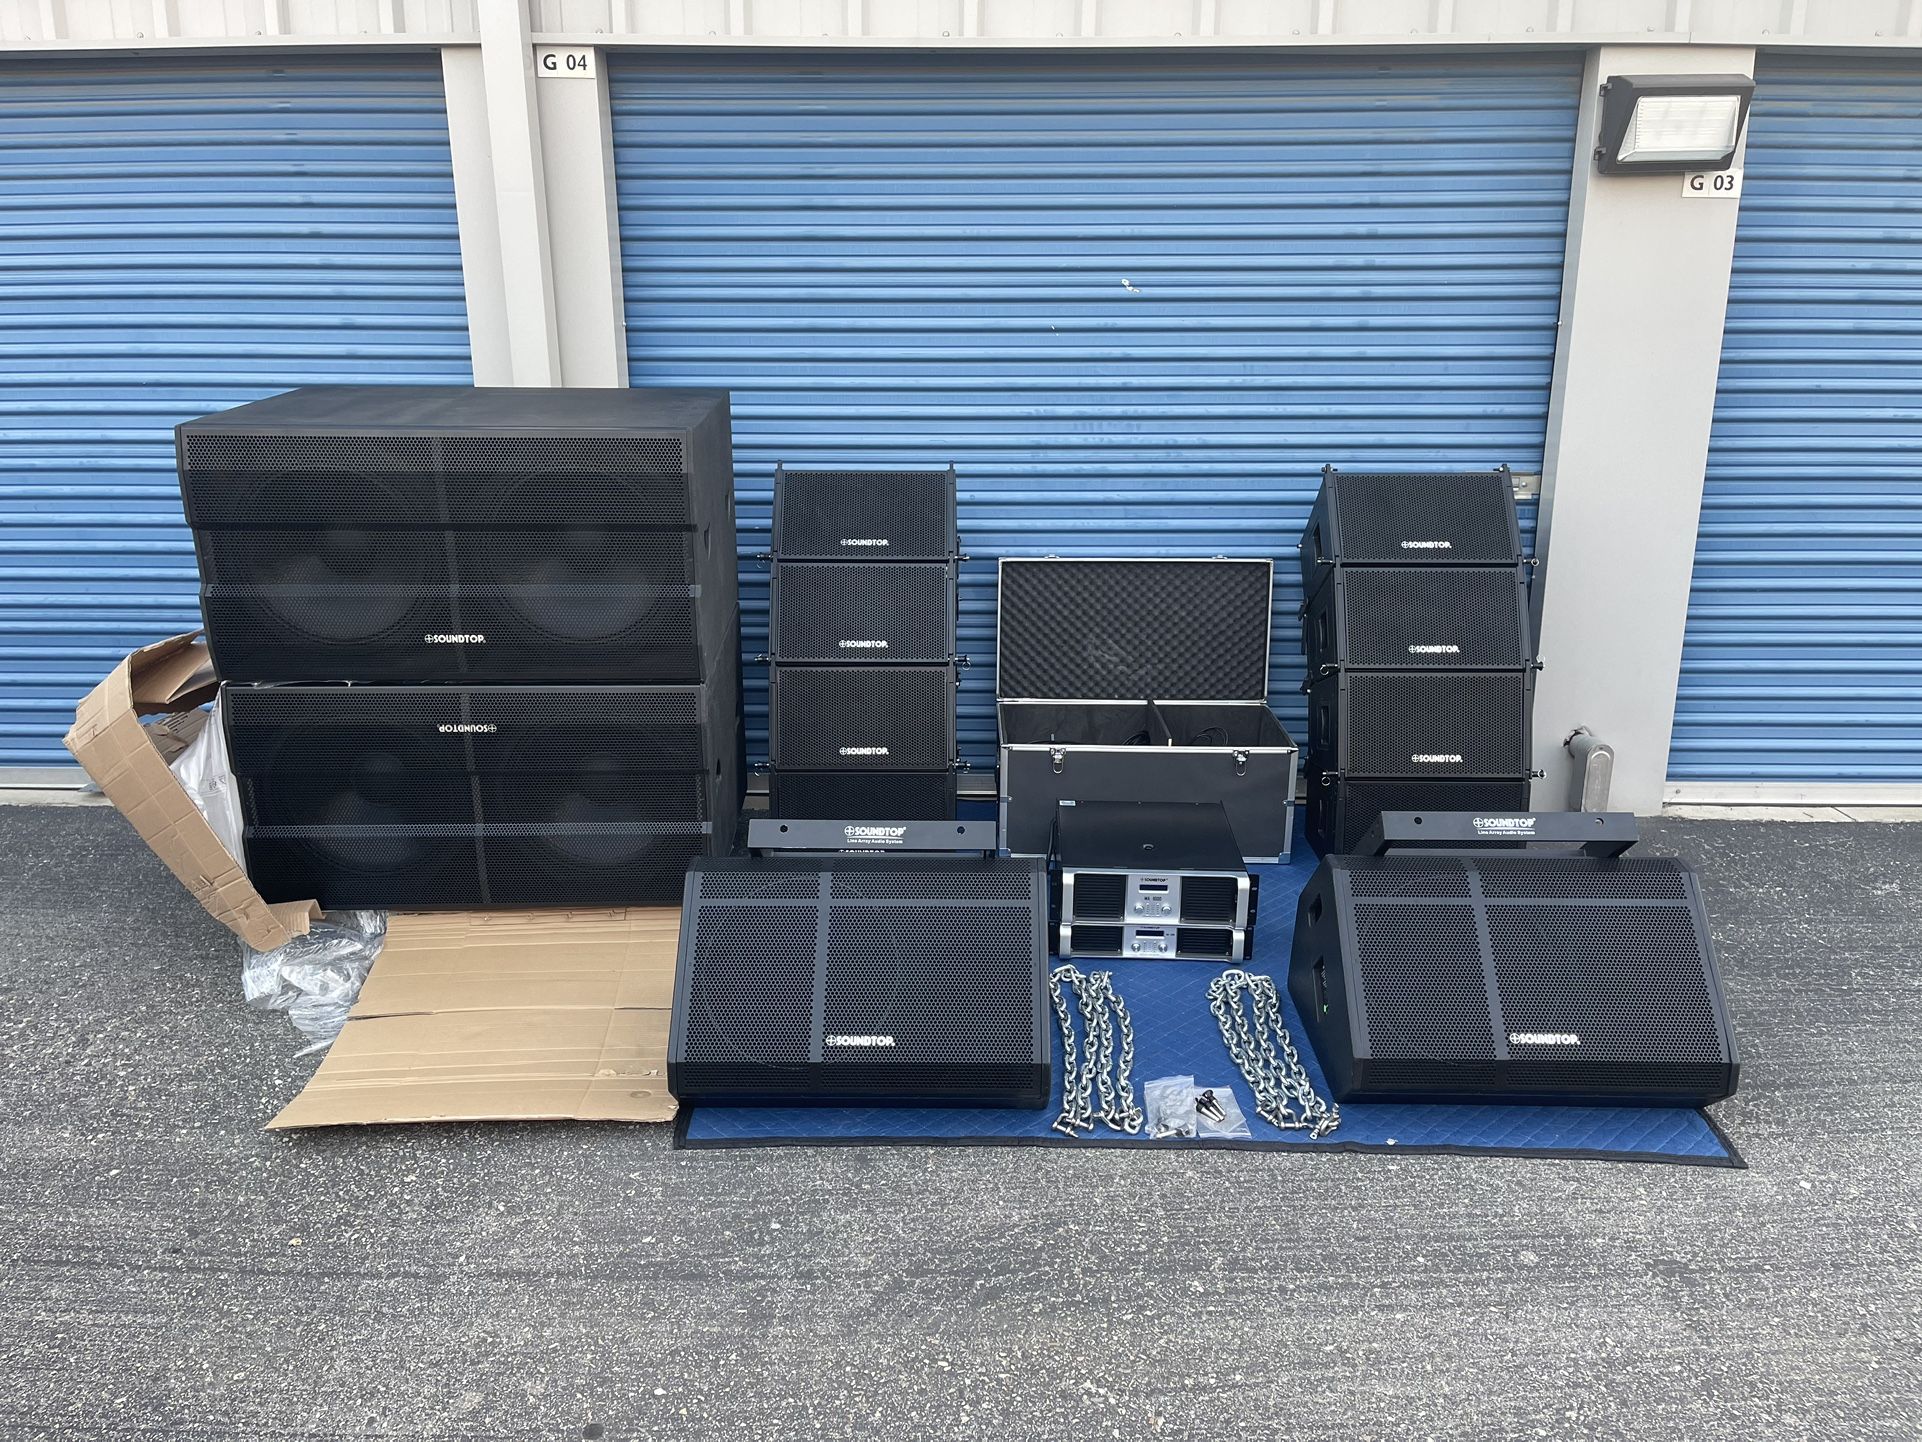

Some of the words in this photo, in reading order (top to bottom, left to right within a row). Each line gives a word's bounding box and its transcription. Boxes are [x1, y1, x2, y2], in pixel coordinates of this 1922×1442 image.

[543, 54, 557, 70] G
[566, 54, 587, 70] 04
[1690, 175, 1704, 190] G
[1714, 175, 1734, 190] 03
[1408, 540, 1451, 548] SOUNDTOP
[433, 634, 485, 644] SOUNDTOP
[846, 640, 888, 648] SOUNDTOP
[1416, 644, 1459, 653] SOUNDTOP
[439, 724, 489, 733] SOUNDTOP
[846, 746, 888, 755] SOUNDTOP
[1419, 754, 1462, 762] SOUNDTOP
[1484, 818, 1535, 828] SOUNDTOP
[854, 826, 905, 836] SOUNDTOP
[836, 1035, 894, 1046] SOUNDTOP
[1520, 1033, 1578, 1045] SOUNDTOP
